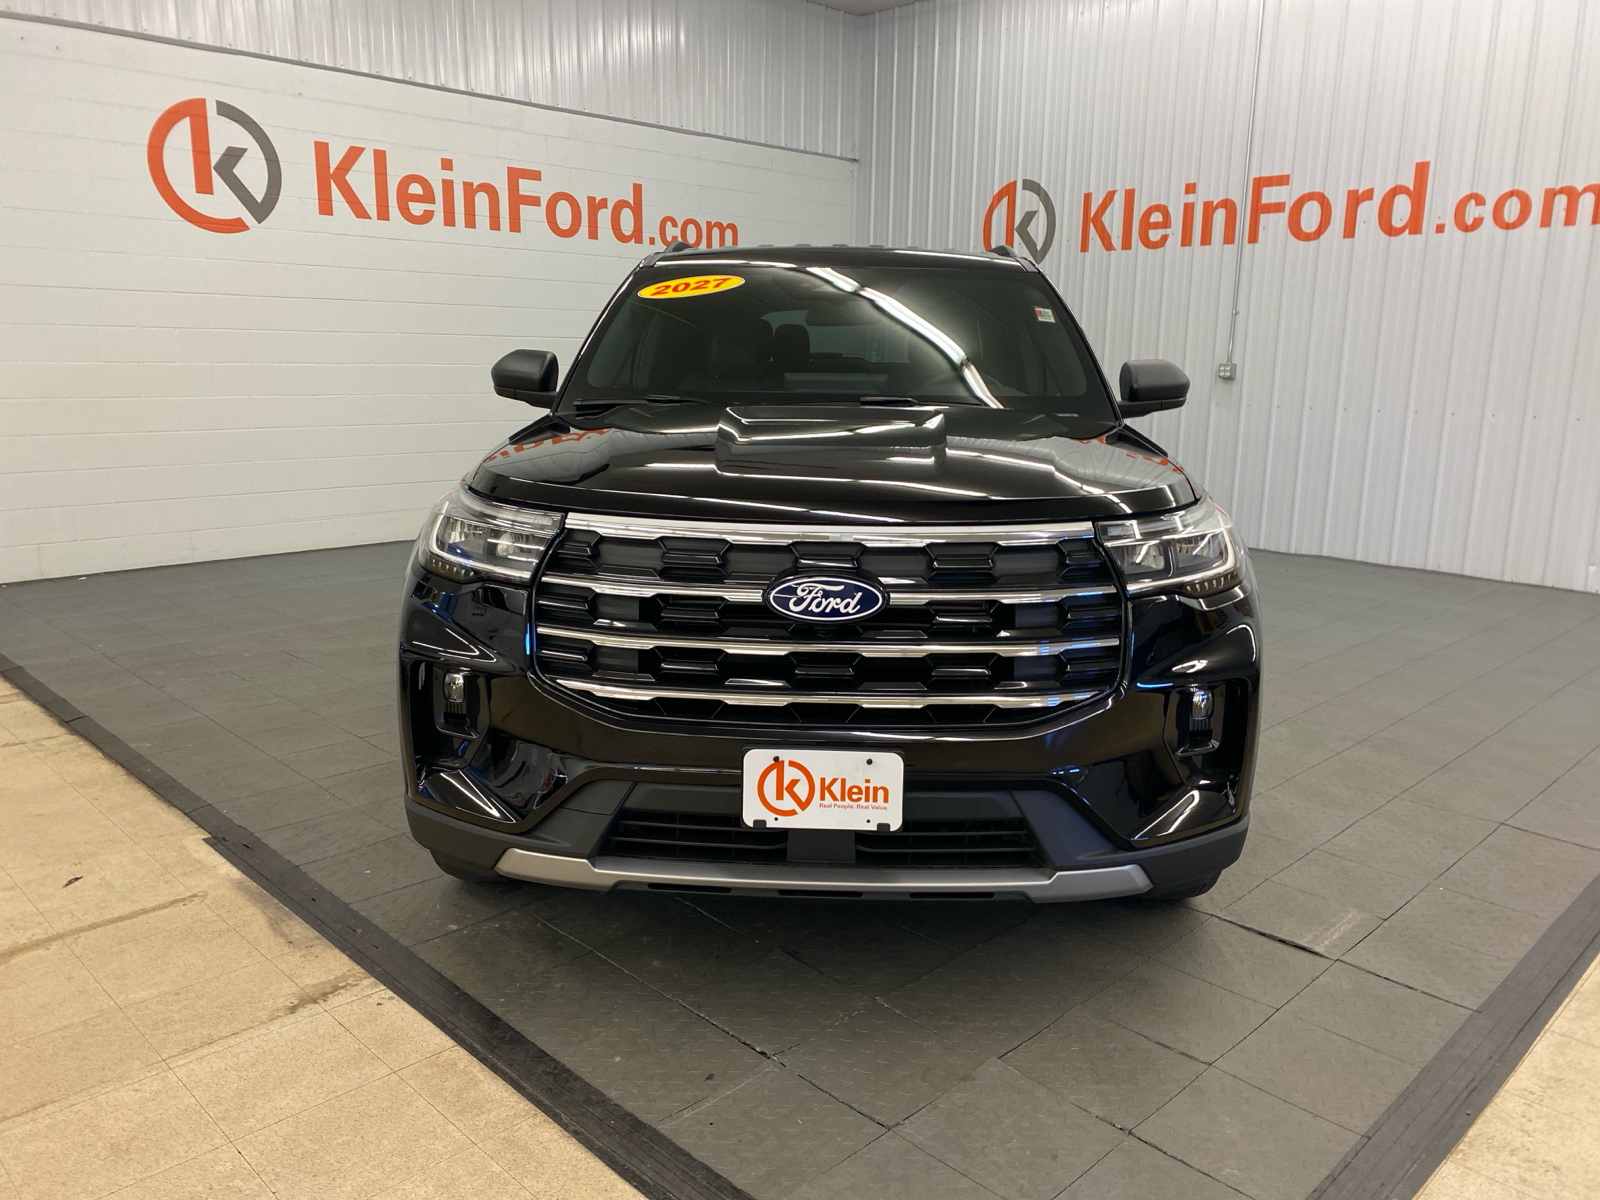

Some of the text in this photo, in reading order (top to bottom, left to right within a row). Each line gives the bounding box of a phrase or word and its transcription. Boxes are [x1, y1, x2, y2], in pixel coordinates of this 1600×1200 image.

[314, 140, 739, 250] KleinFord.com
[1079, 160, 1600, 254] KleinFord.com
[650, 277, 732, 296] 2027
[788, 582, 863, 614] Ford
[818, 777, 890, 804] Klein
